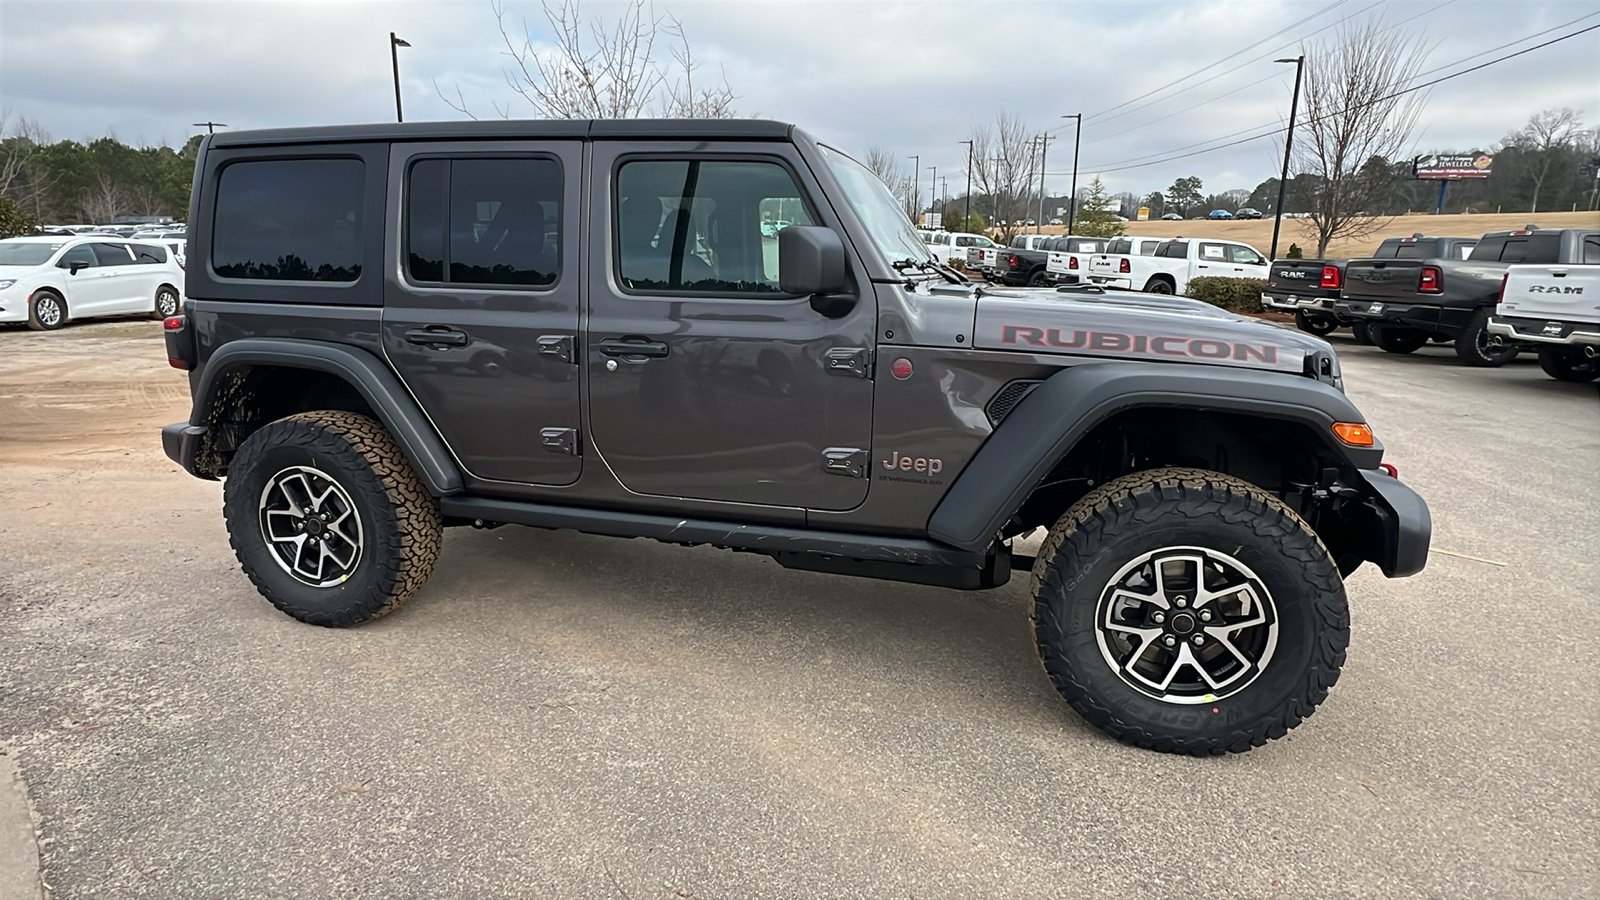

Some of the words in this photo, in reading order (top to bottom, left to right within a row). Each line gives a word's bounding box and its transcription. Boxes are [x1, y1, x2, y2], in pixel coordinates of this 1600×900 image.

[1529, 285, 1583, 294] RAM
[1001, 325, 1277, 364] RUBICON
[883, 451, 942, 476] Jeep
